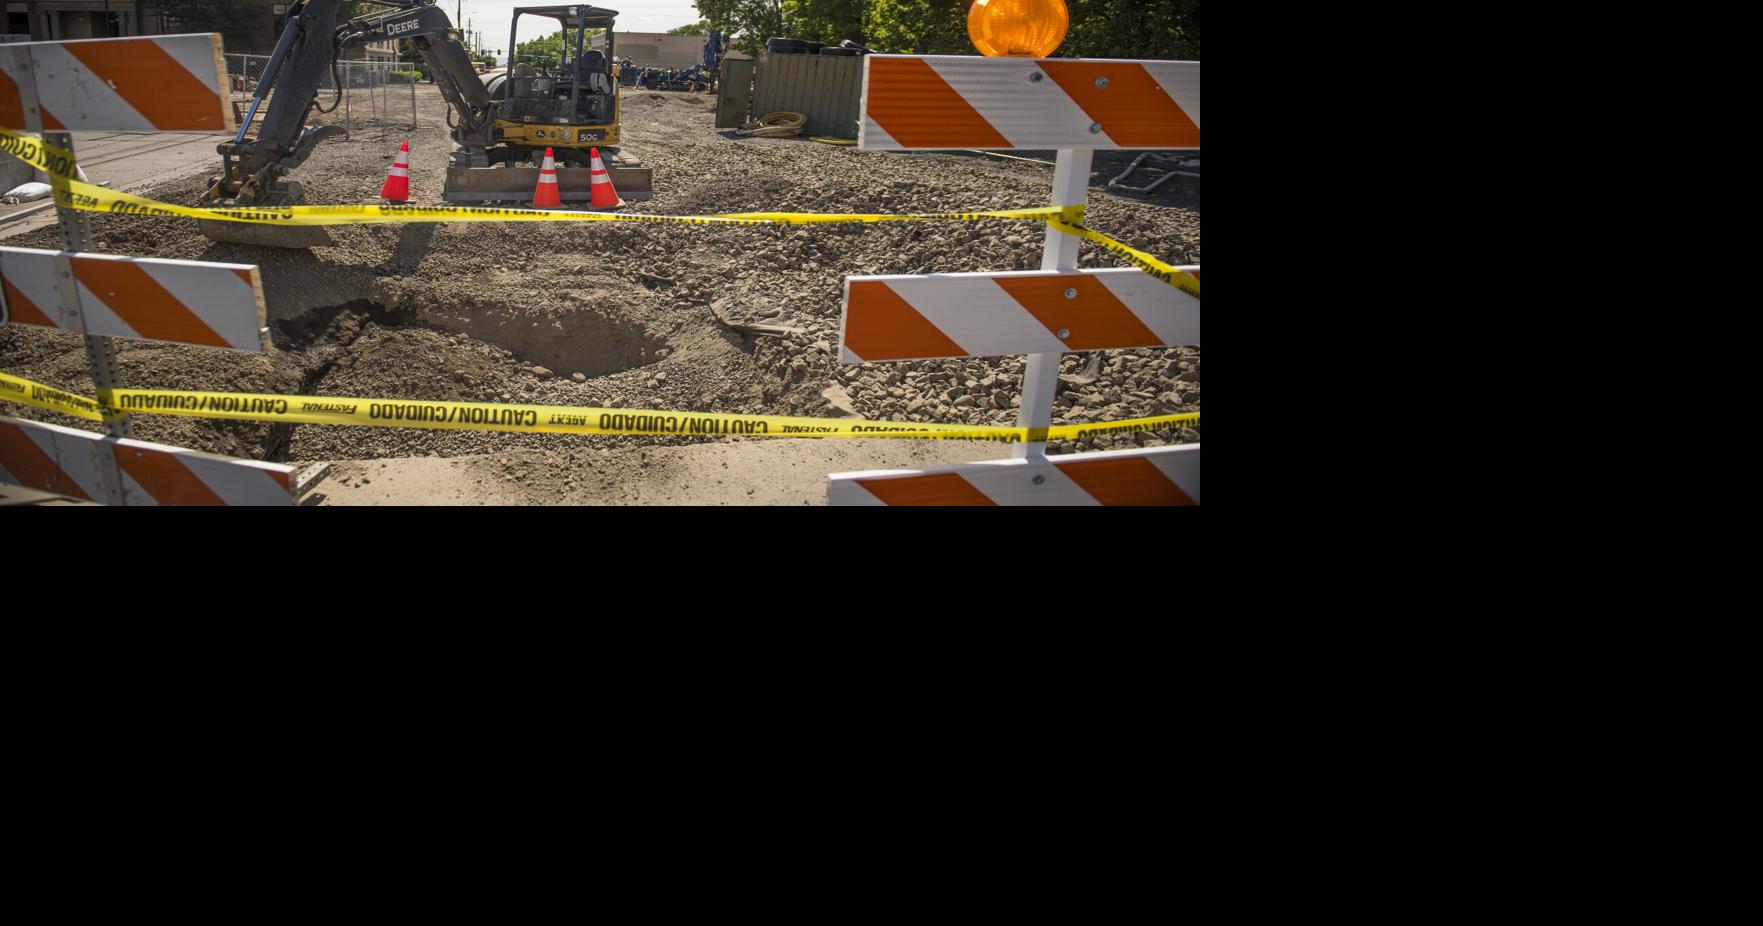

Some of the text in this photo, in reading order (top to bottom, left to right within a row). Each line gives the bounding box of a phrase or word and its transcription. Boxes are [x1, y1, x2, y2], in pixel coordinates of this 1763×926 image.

[386, 18, 420, 36] DEERE
[580, 132, 598, 142] 50G
[119, 393, 288, 415] CAUTION/CUIDADO
[368, 403, 538, 427] CAUTION/CUIDADO
[599, 413, 768, 434] CAUTION/CUIDADO
